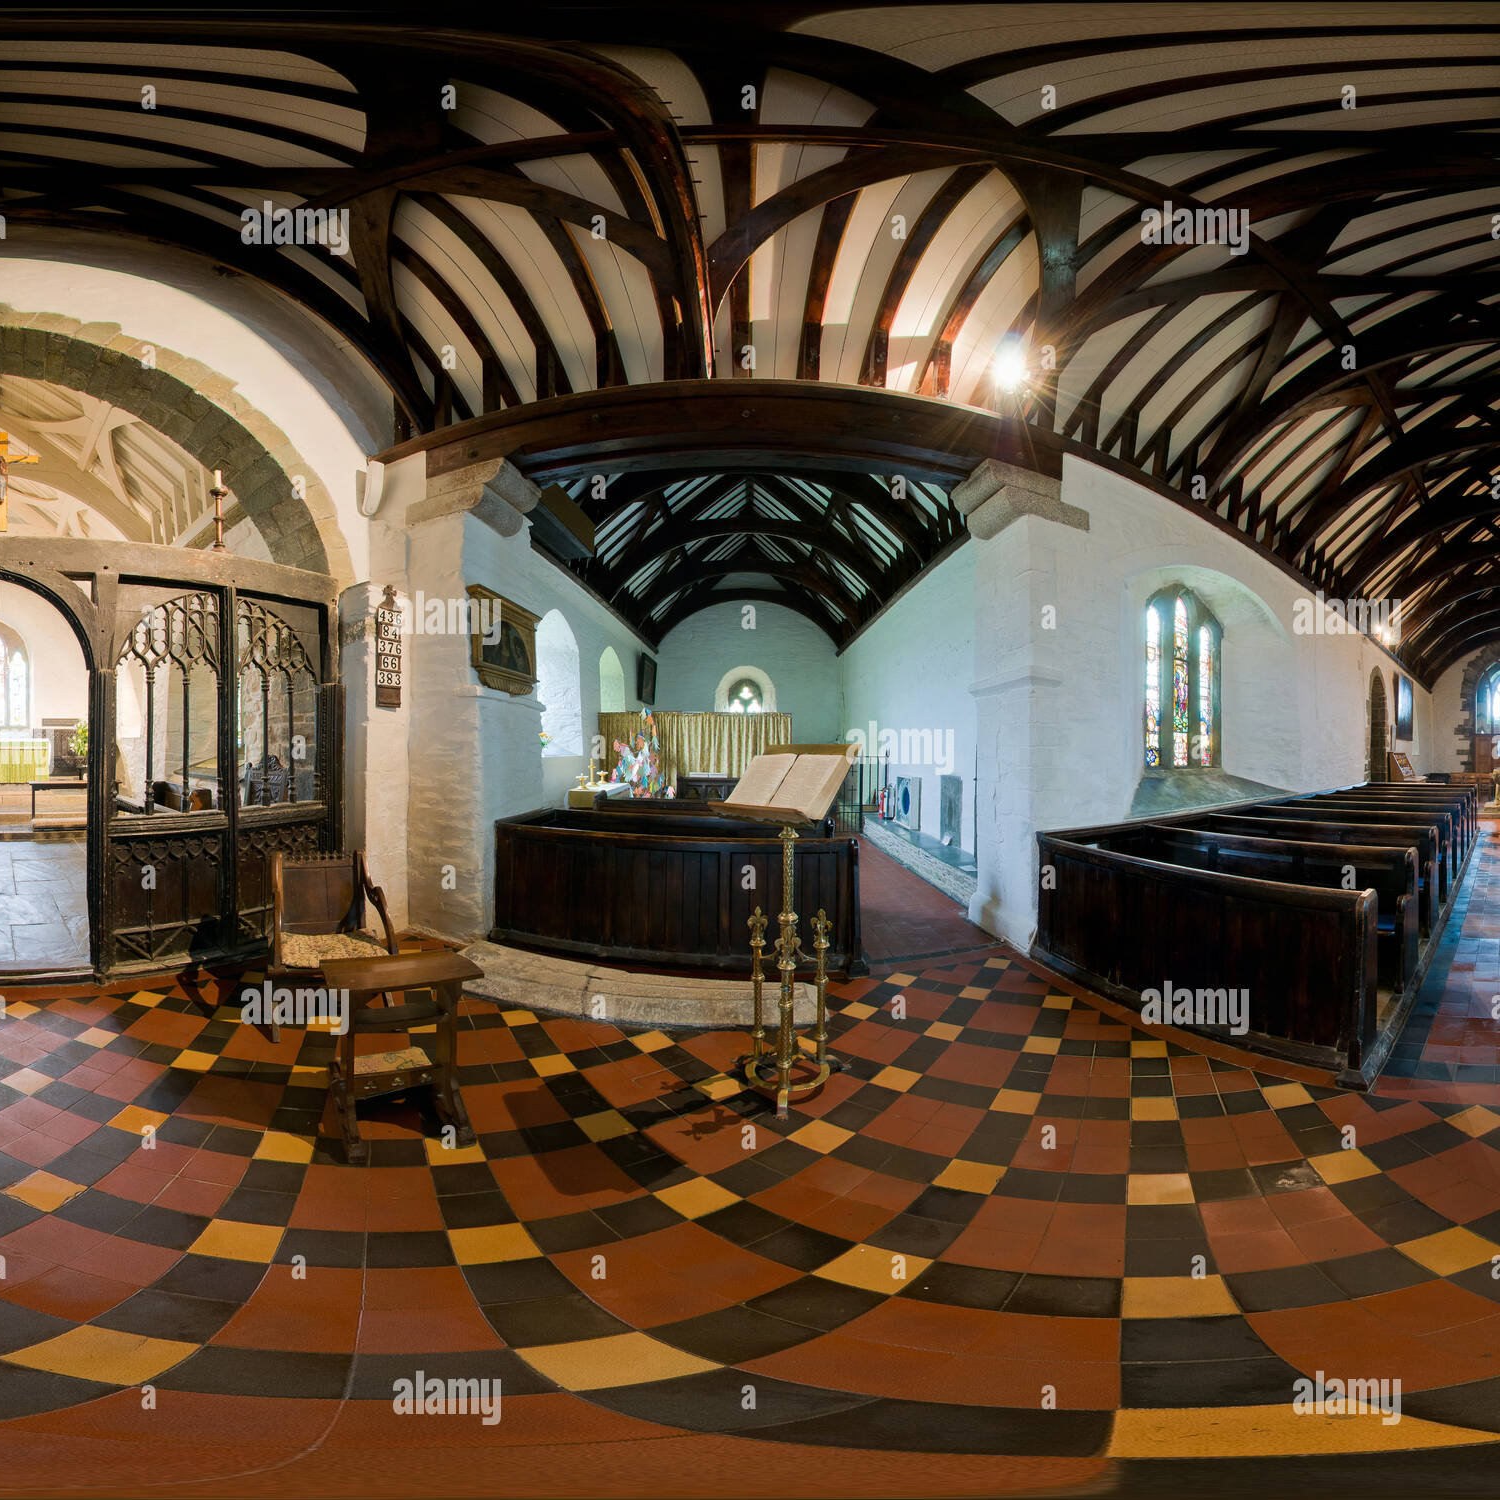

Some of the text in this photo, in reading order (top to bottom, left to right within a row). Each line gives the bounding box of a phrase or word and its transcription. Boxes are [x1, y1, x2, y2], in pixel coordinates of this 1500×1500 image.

[379, 610, 401, 624] 436
[383, 625, 397, 638] 84
[379, 641, 401, 654] 376
[383, 657, 396, 669] 66
[379, 672, 400, 685] 383
